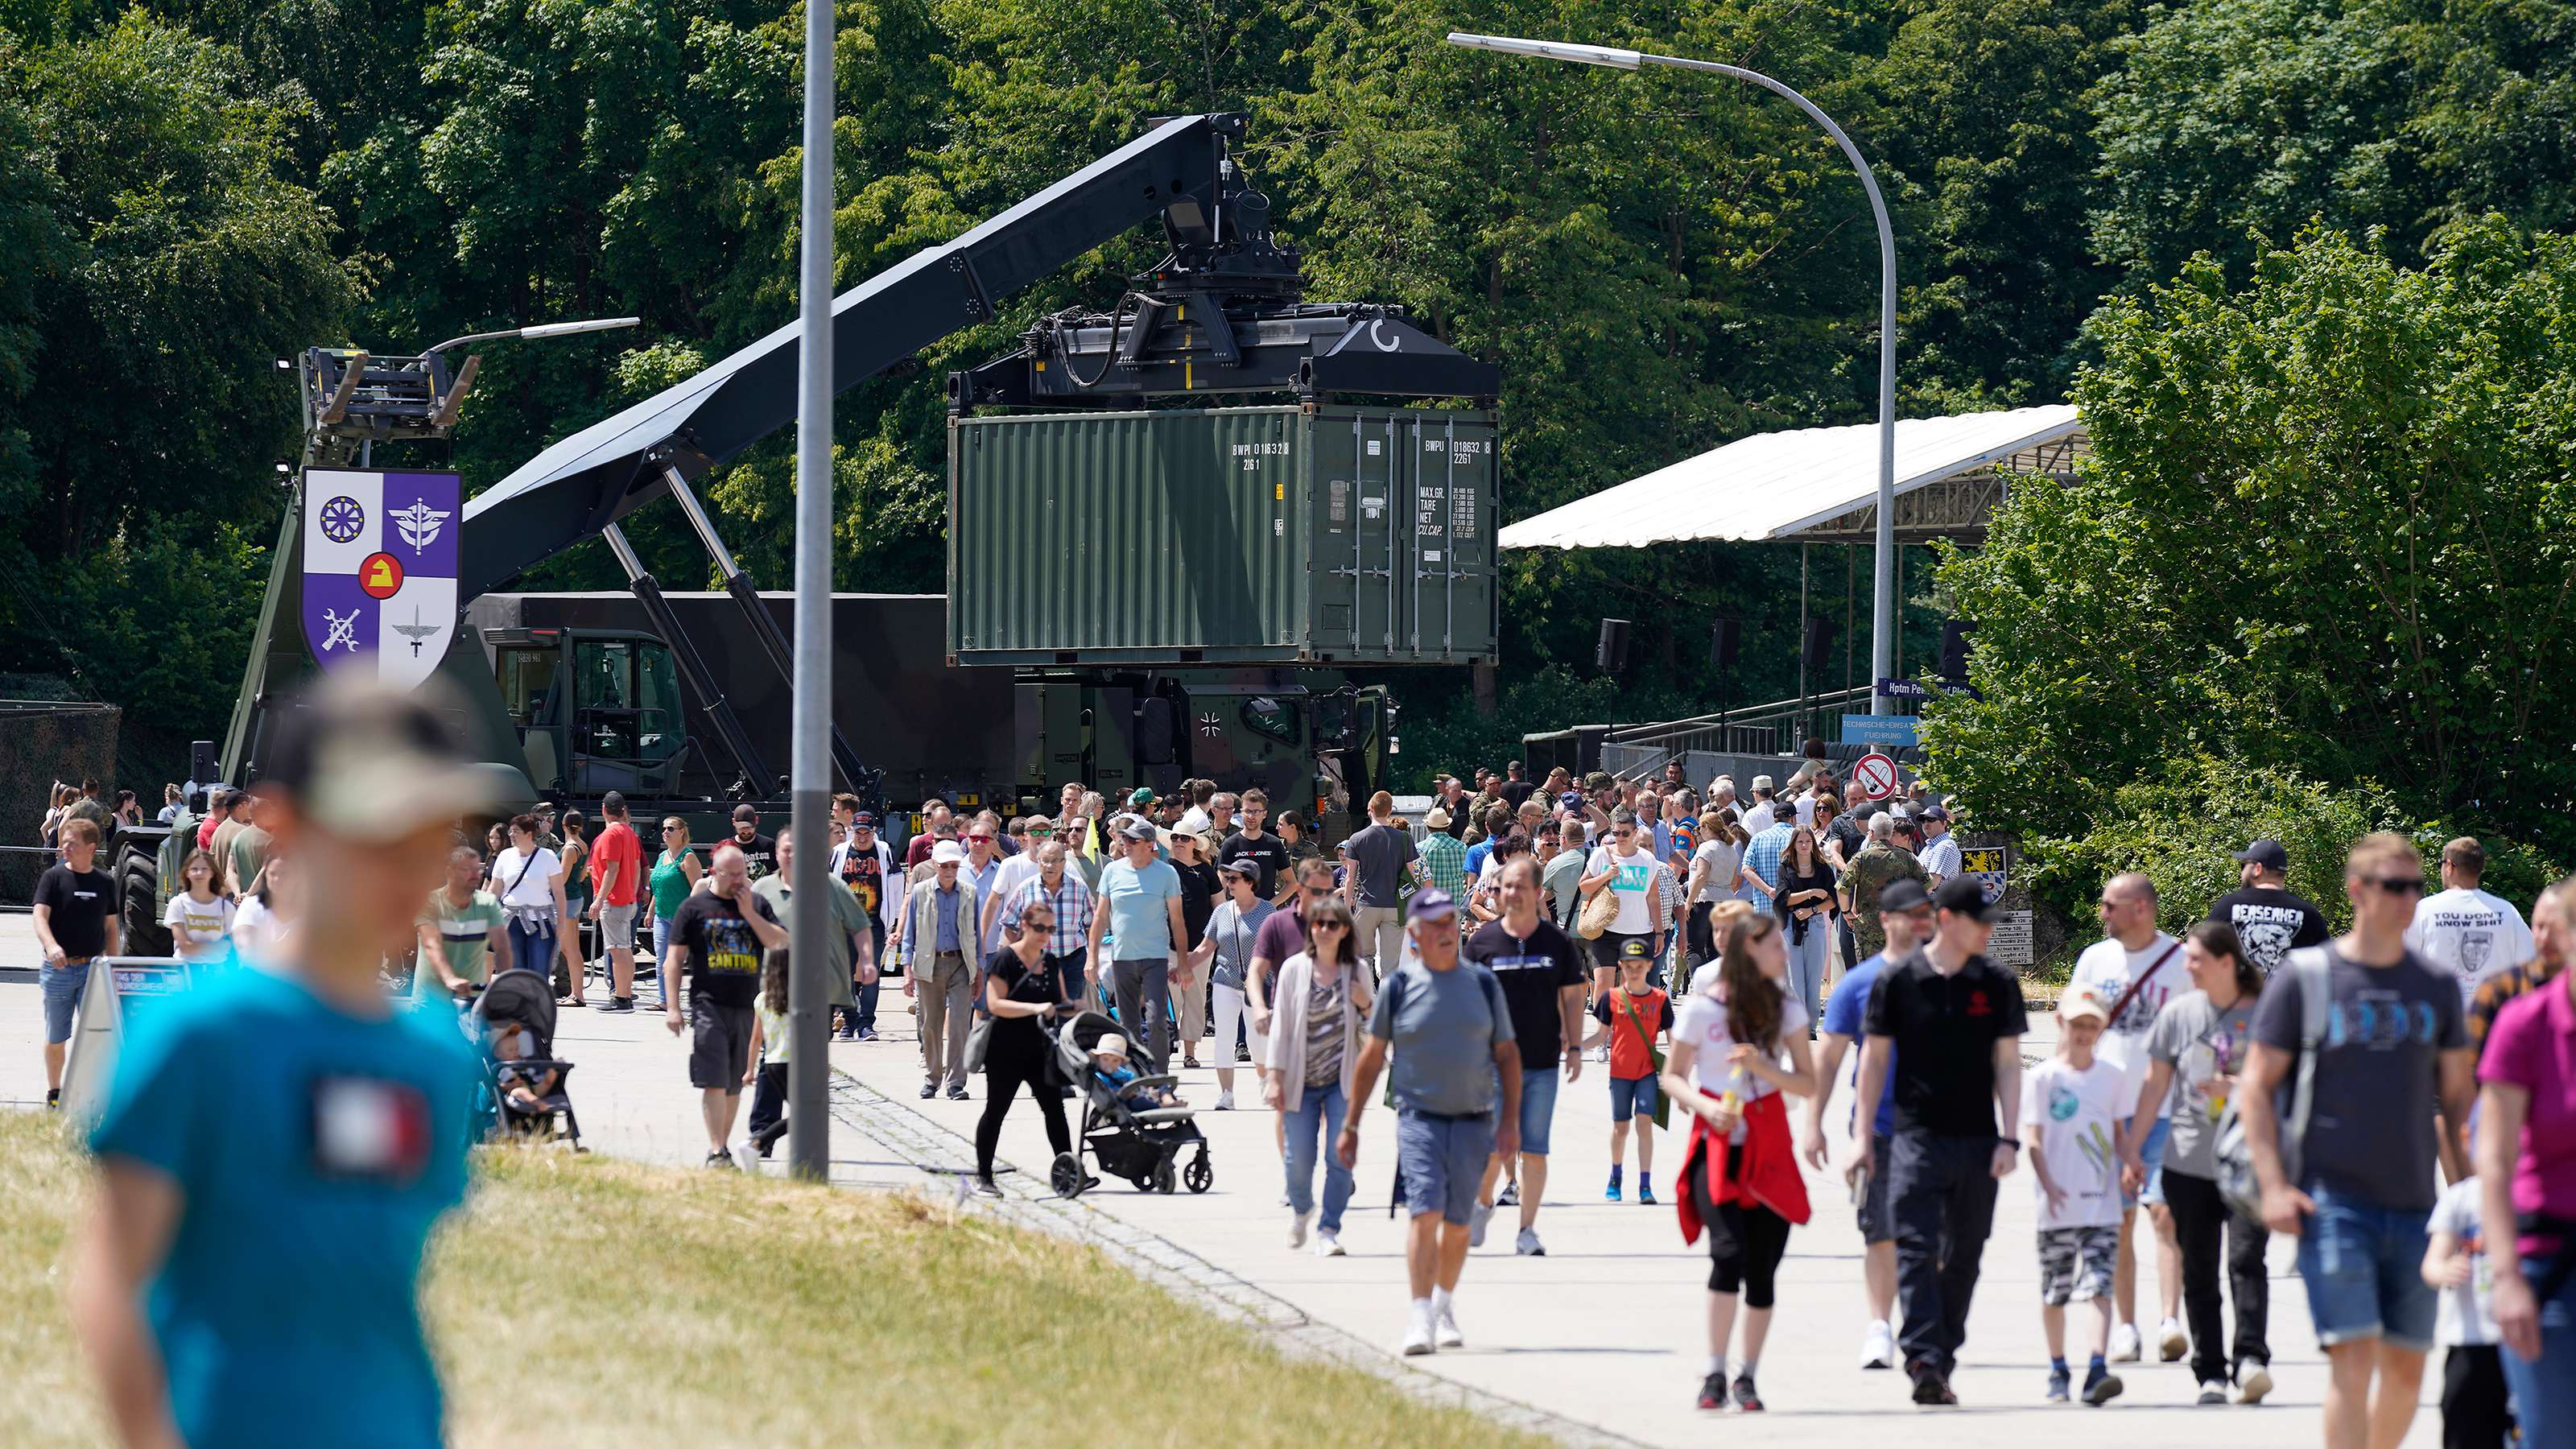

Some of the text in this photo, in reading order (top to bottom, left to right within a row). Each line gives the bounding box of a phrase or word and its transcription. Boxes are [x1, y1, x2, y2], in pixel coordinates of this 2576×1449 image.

[1425, 440, 1491, 455] BWPU 018632 8
[1454, 453, 1471, 464] 22G1
[1420, 486, 1445, 499] MAX.GR.
[1420, 499, 1436, 511] TARE
[1419, 512, 1432, 523] NET
[1418, 525, 1443, 536] CU.CAP.
[1889, 682, 1909, 696] Hptm
[1864, 732, 1901, 740] FUEHRUNG
[2476, 919, 2503, 927] SHIT
